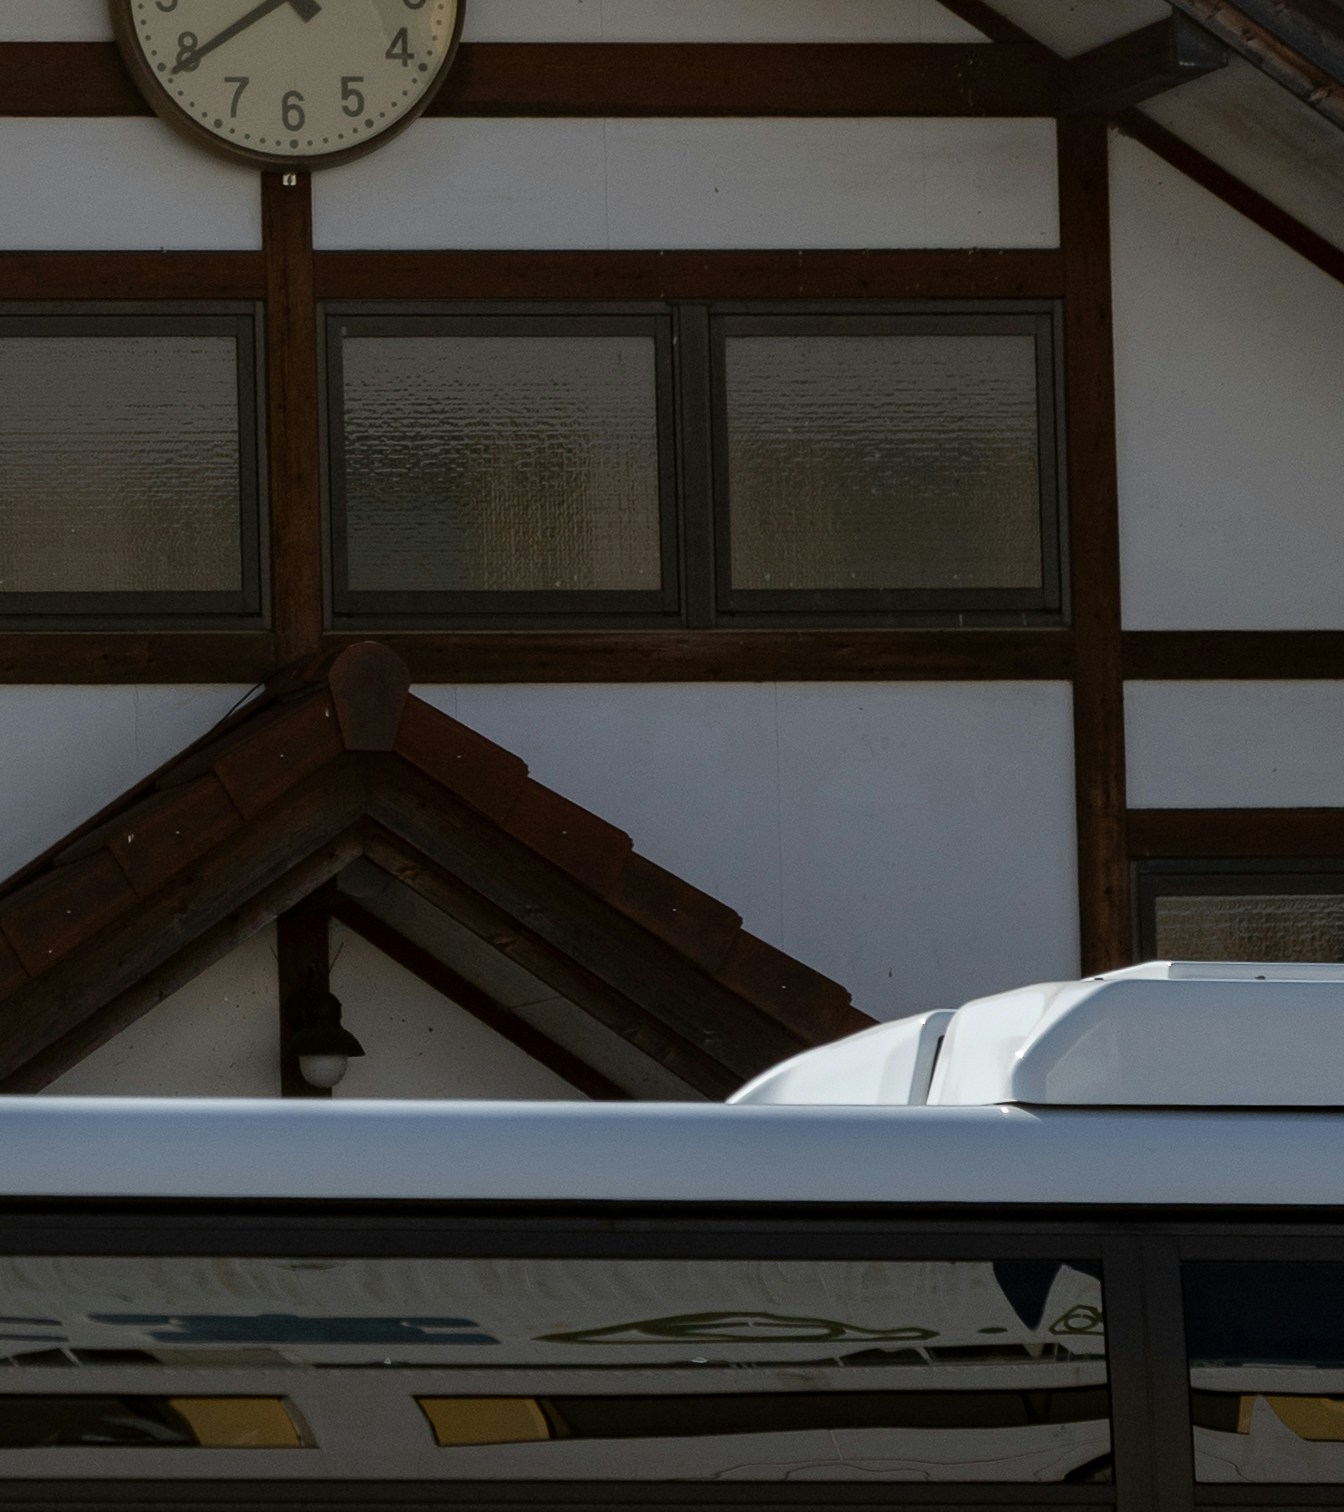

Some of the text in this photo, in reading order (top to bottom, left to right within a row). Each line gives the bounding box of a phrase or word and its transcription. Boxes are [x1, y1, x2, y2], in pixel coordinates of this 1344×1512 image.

[175, 31, 201, 73] 8
[384, 27, 415, 68] 4
[224, 76, 250, 118] 7
[281, 90, 306, 132] 6
[340, 76, 365, 118] 5
